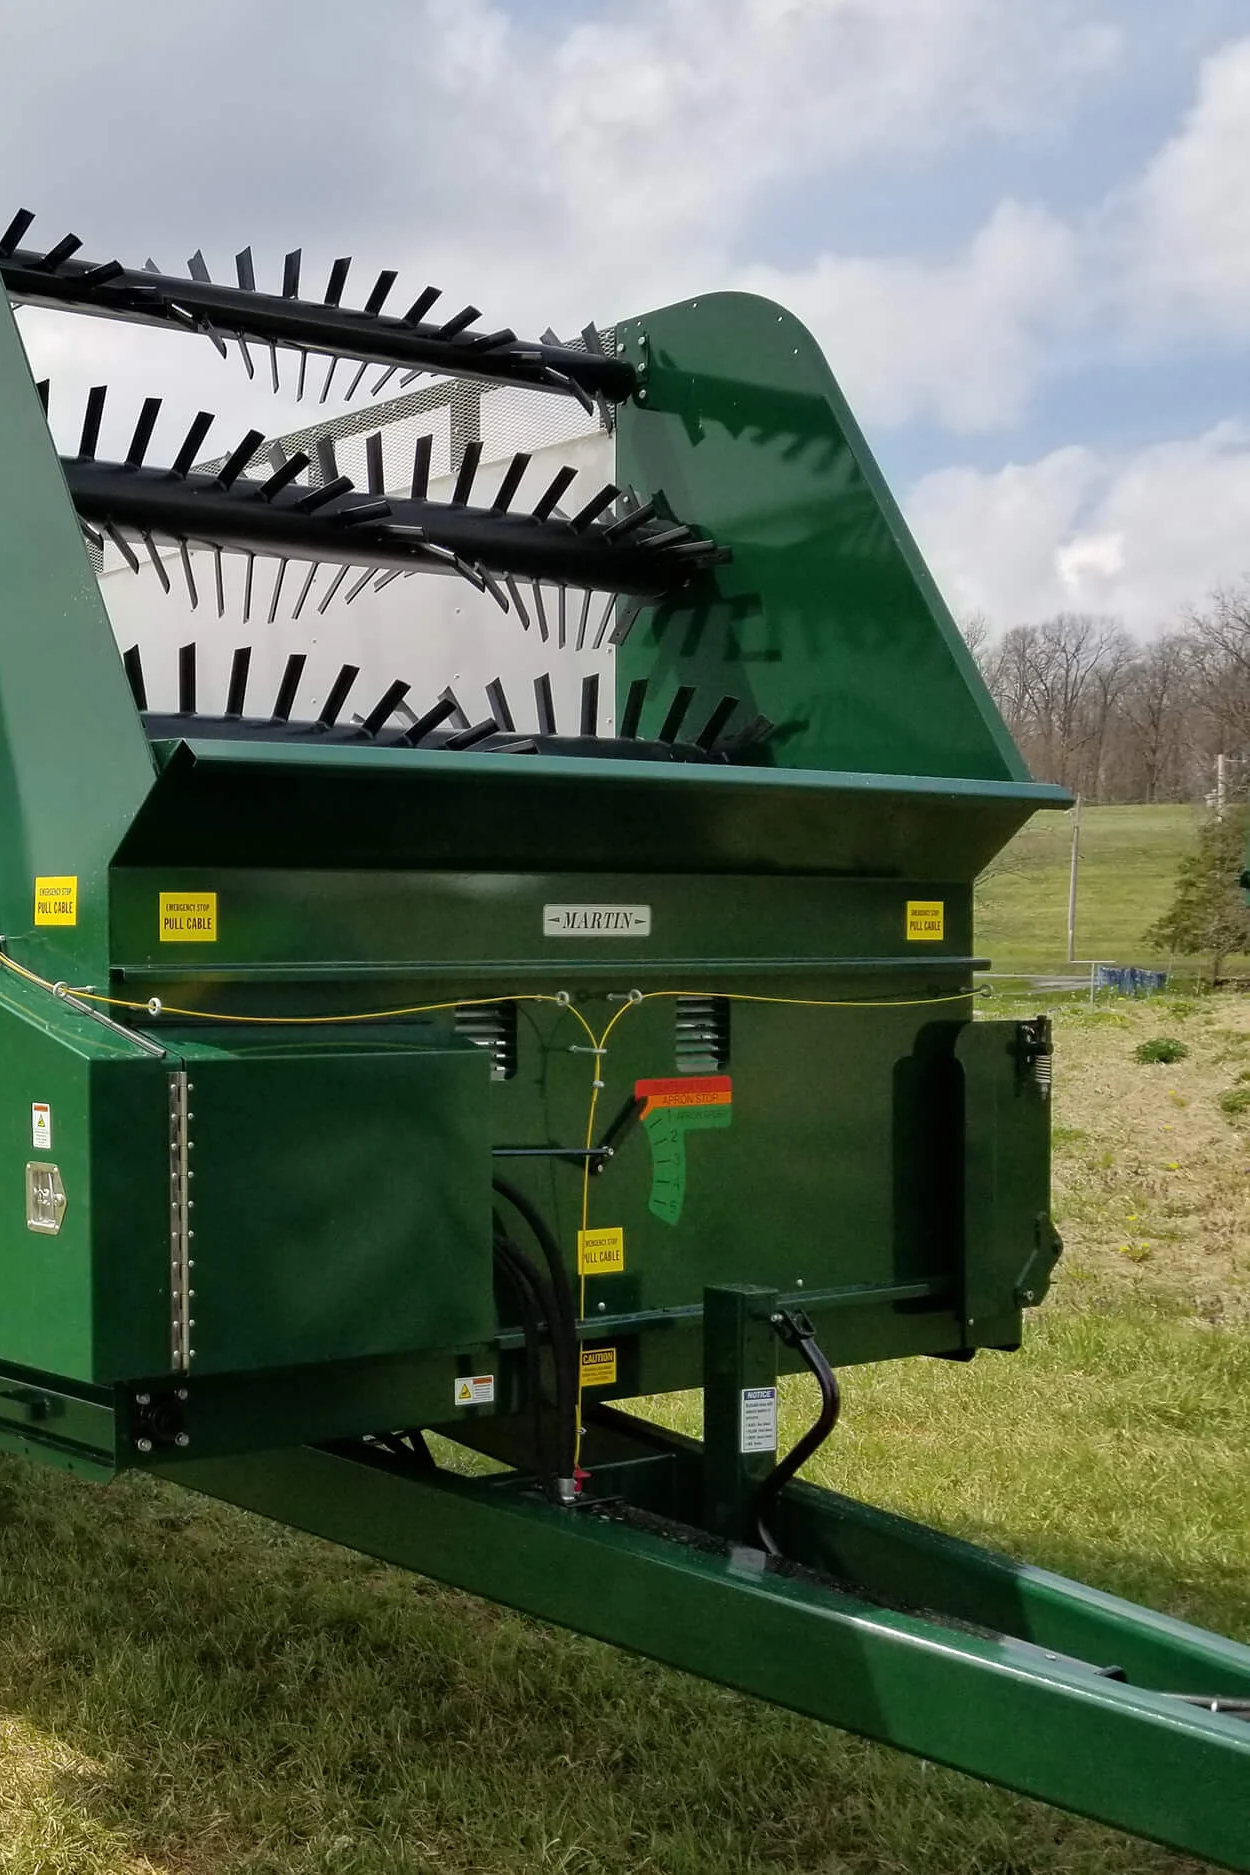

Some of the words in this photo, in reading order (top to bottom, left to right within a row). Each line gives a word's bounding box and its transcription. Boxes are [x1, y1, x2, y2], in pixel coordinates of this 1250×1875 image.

[38, 902, 52, 914] PULL
[54, 901, 73, 914] CABLE
[166, 904, 195, 912] EMERGENCY
[196, 904, 210, 912] STOP
[164, 918, 184, 930] PULL
[186, 918, 212, 930] CABLE
[562, 911, 634, 929] MARTIN
[662, 1095, 693, 1105] APRON
[695, 1093, 718, 1104] STOP
[670, 1128, 678, 1142] 2
[582, 1252, 598, 1263] ULL
[600, 1250, 620, 1262] CABLE
[582, 1352, 613, 1364] CAUTION
[747, 1390, 772, 1399] NOTICE
